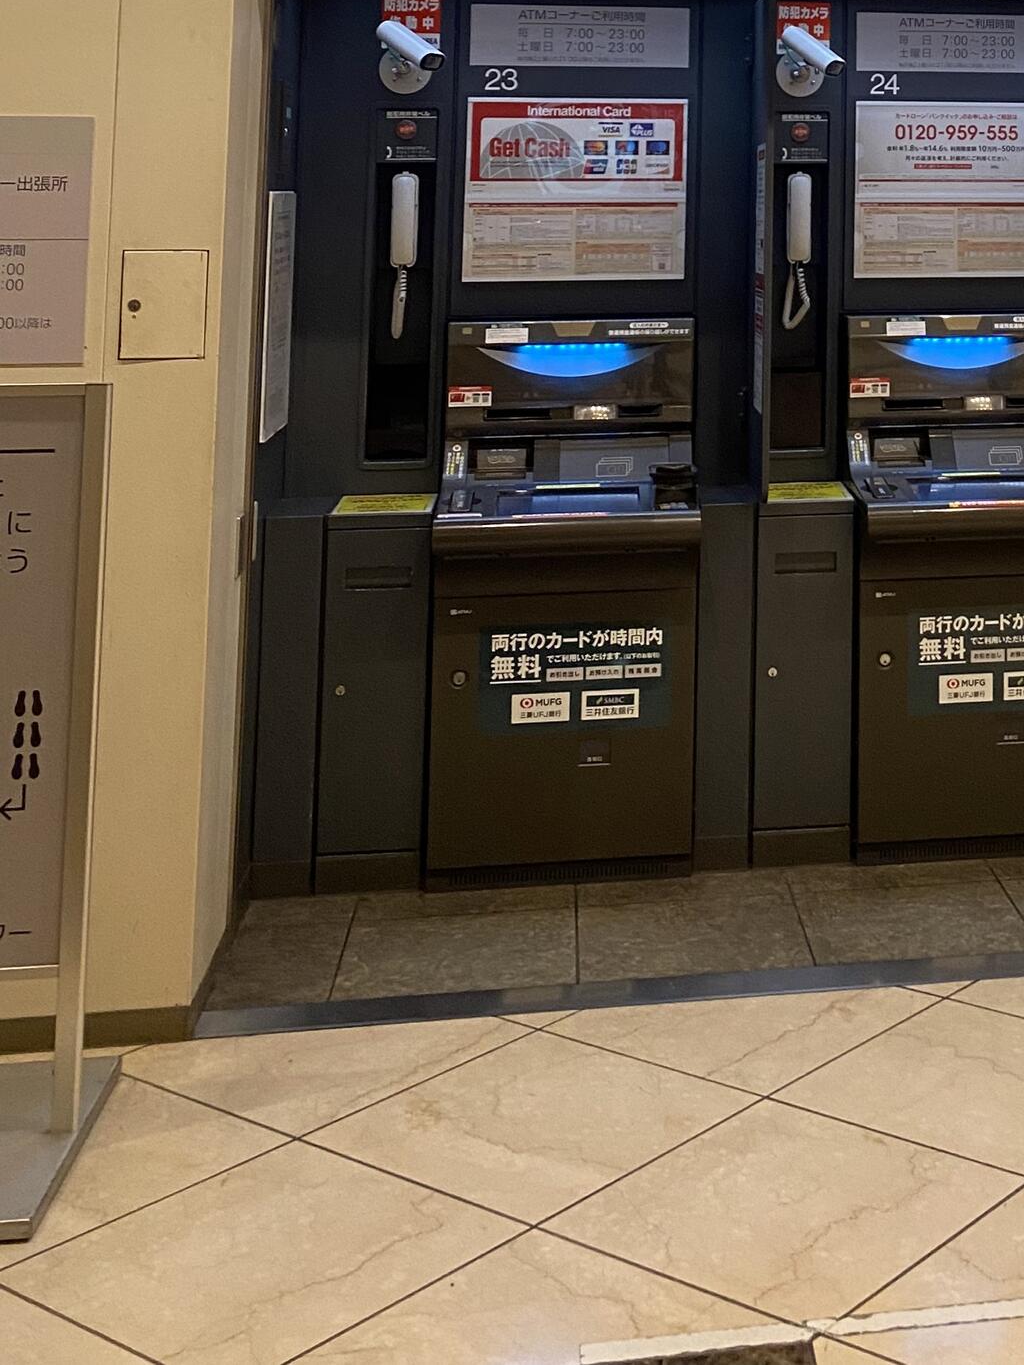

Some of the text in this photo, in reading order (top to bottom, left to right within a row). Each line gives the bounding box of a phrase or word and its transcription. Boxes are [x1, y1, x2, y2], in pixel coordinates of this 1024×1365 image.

[518, 9, 647, 23] ATMコーナーご利用時間
[778, 5, 830, 20] 防犯カメラ
[899, 17, 1016, 31] ATMコーナーご利用時間
[518, 41, 554, 53] 土曜日
[899, 47, 932, 59] 土曜日
[484, 68, 519, 91] 23
[870, 73, 901, 95] 24
[527, 105, 632, 118] International Card
[602, 125, 621, 134] VISA
[894, 124, 1019, 141] 0120-959-555
[488, 137, 520, 158] Get
[524, 137, 571, 159] Cash
[7, 510, 33, 535] に
[491, 627, 663, 652] 両行のカードが時間内
[918, 635, 966, 661] 無料
[490, 654, 542, 680] 無料
[961, 678, 986, 687] MUFG
[535, 697, 562, 706] MUFG
[603, 696, 625, 704] SMBC
[585, 707, 635, 717] 三井住友銀行
